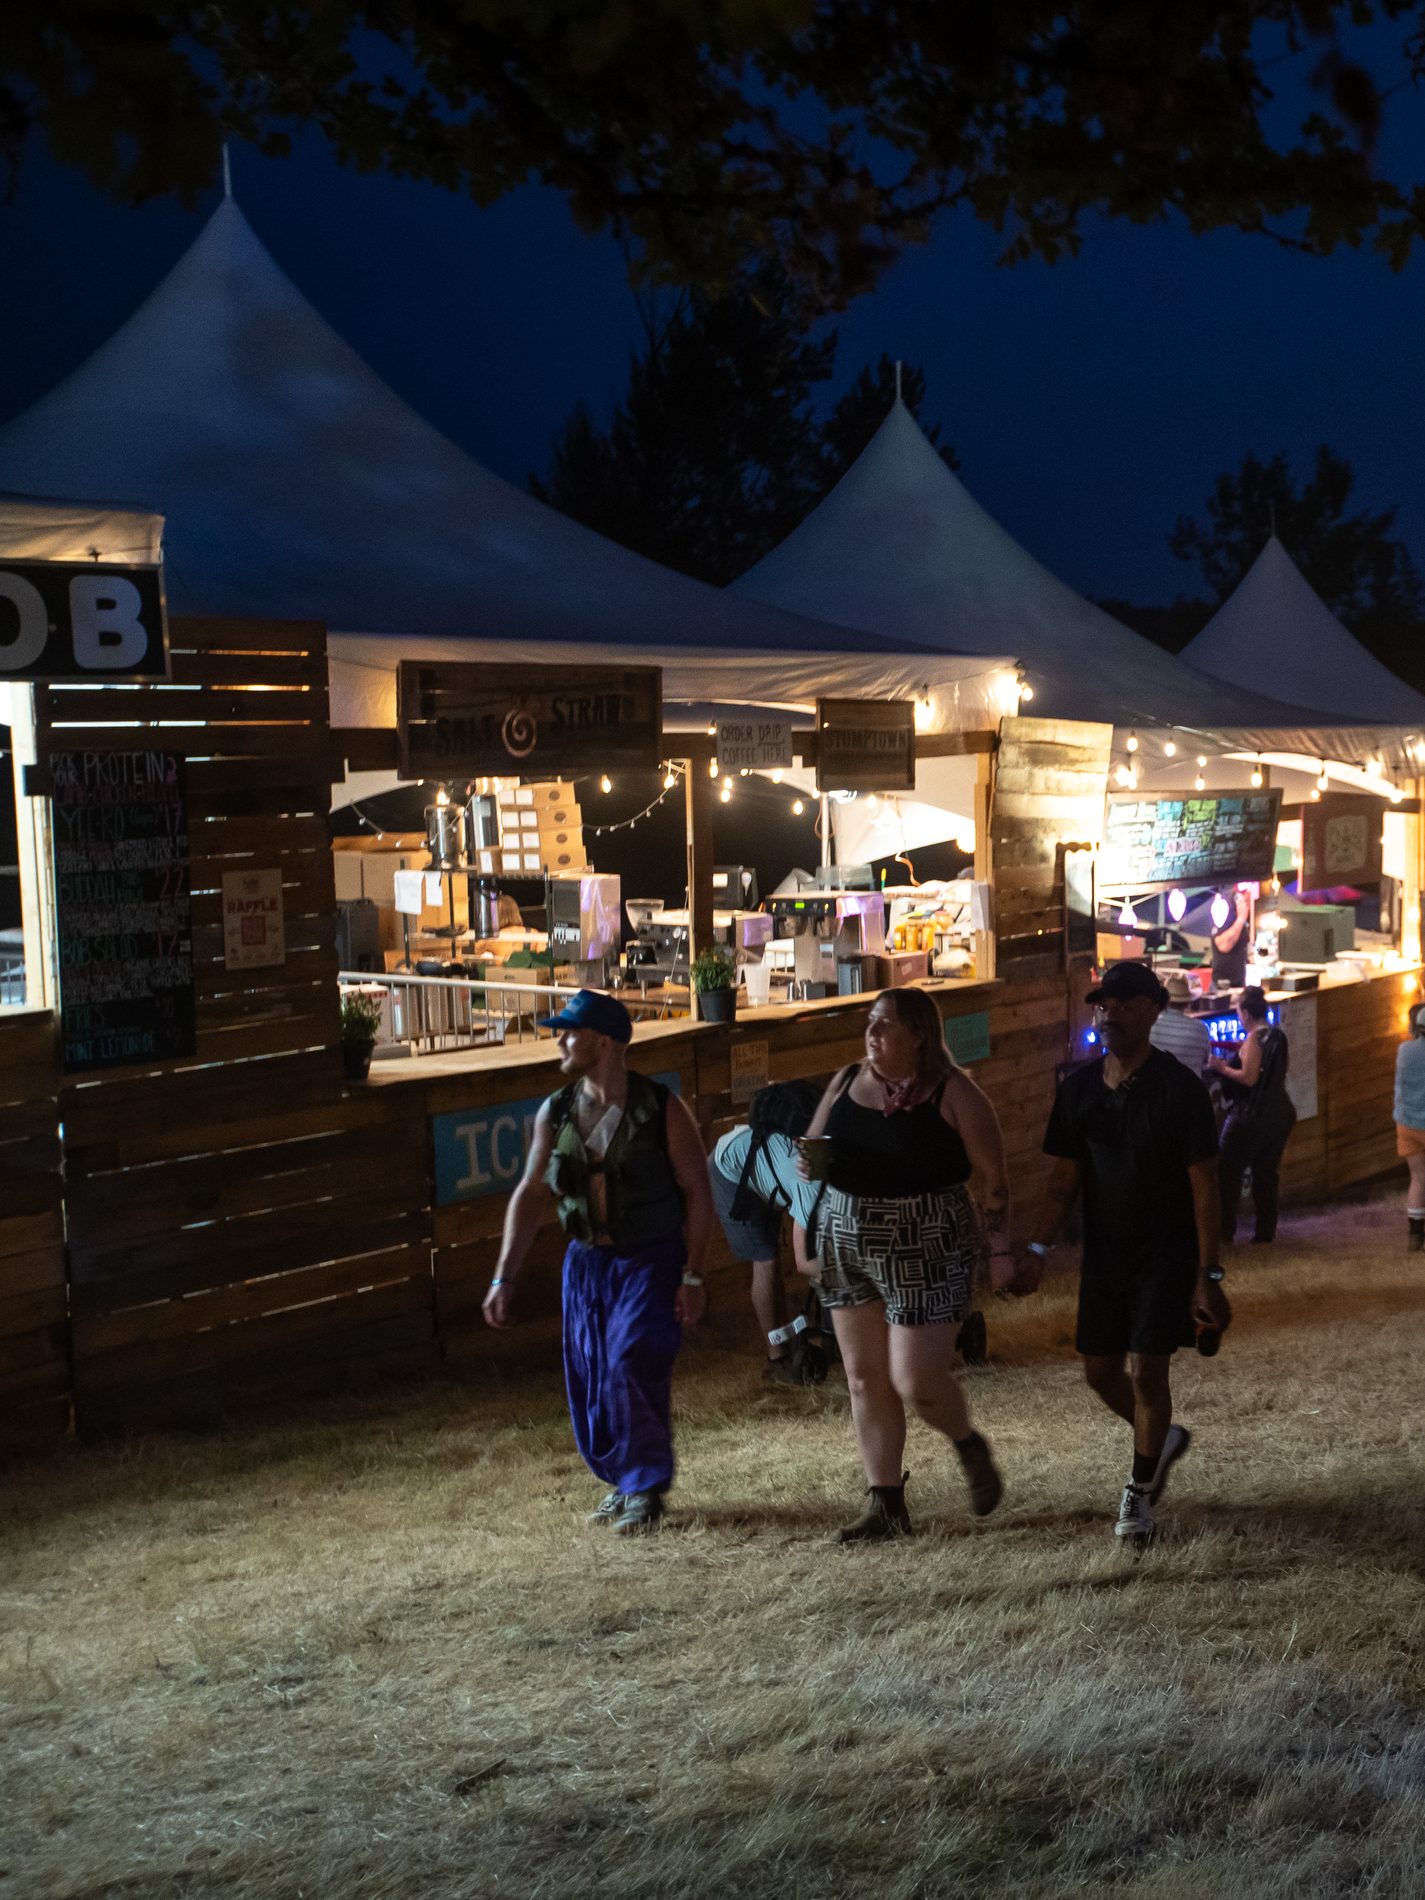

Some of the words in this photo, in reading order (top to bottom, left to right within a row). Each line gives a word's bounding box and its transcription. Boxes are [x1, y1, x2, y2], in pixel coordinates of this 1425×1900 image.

[436, 715, 496, 758] SALT
[550, 693, 622, 736] STRAW
[721, 726, 753, 744] ORDER
[757, 724, 783, 742] DRIP
[824, 726, 911, 752] STUMPTOWN
[722, 746, 757, 765] COFFEE
[761, 745, 788, 763] HERE
[83, 751, 165, 787] PROTEIN
[228, 898, 279, 914] RAFFLE
[66, 1040, 94, 1063] MINT
